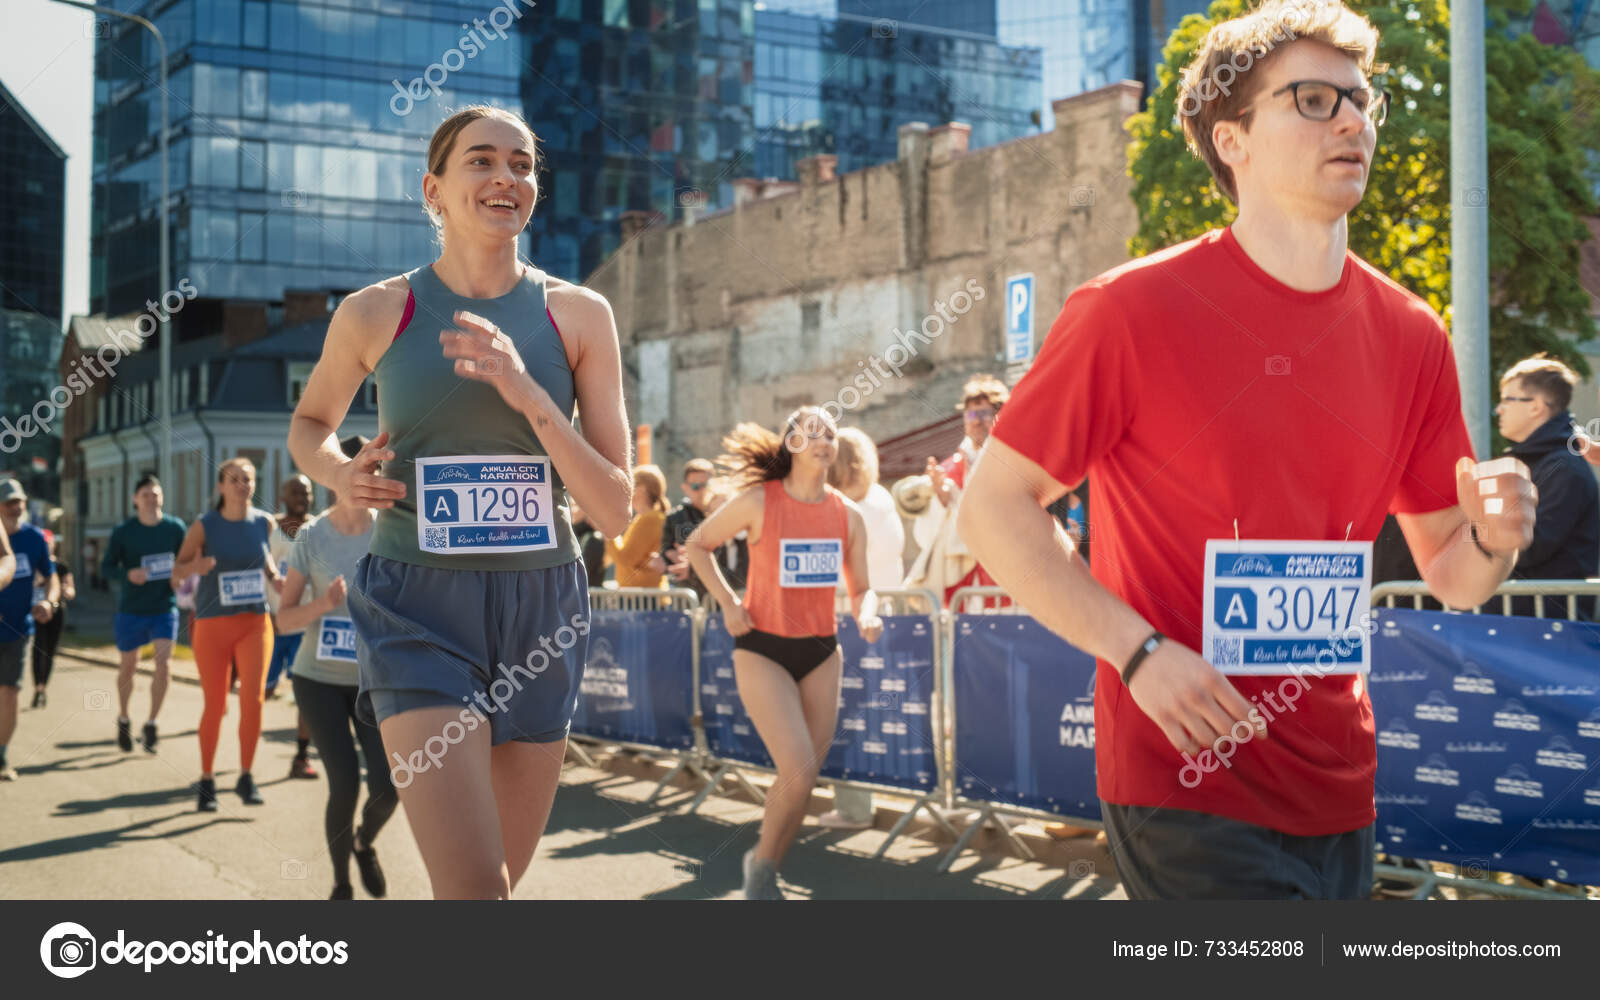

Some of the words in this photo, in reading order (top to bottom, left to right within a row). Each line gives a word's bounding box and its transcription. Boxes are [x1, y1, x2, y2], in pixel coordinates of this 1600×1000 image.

[1011, 283, 1028, 329] P
[480, 465, 518, 473] ANNUAL
[518, 465, 539, 473] CITY
[480, 472, 539, 481] MARATHON
[433, 496, 451, 518] A
[467, 487, 540, 522] 1296
[1224, 593, 1248, 624] A
[1267, 584, 1361, 632] 3047
